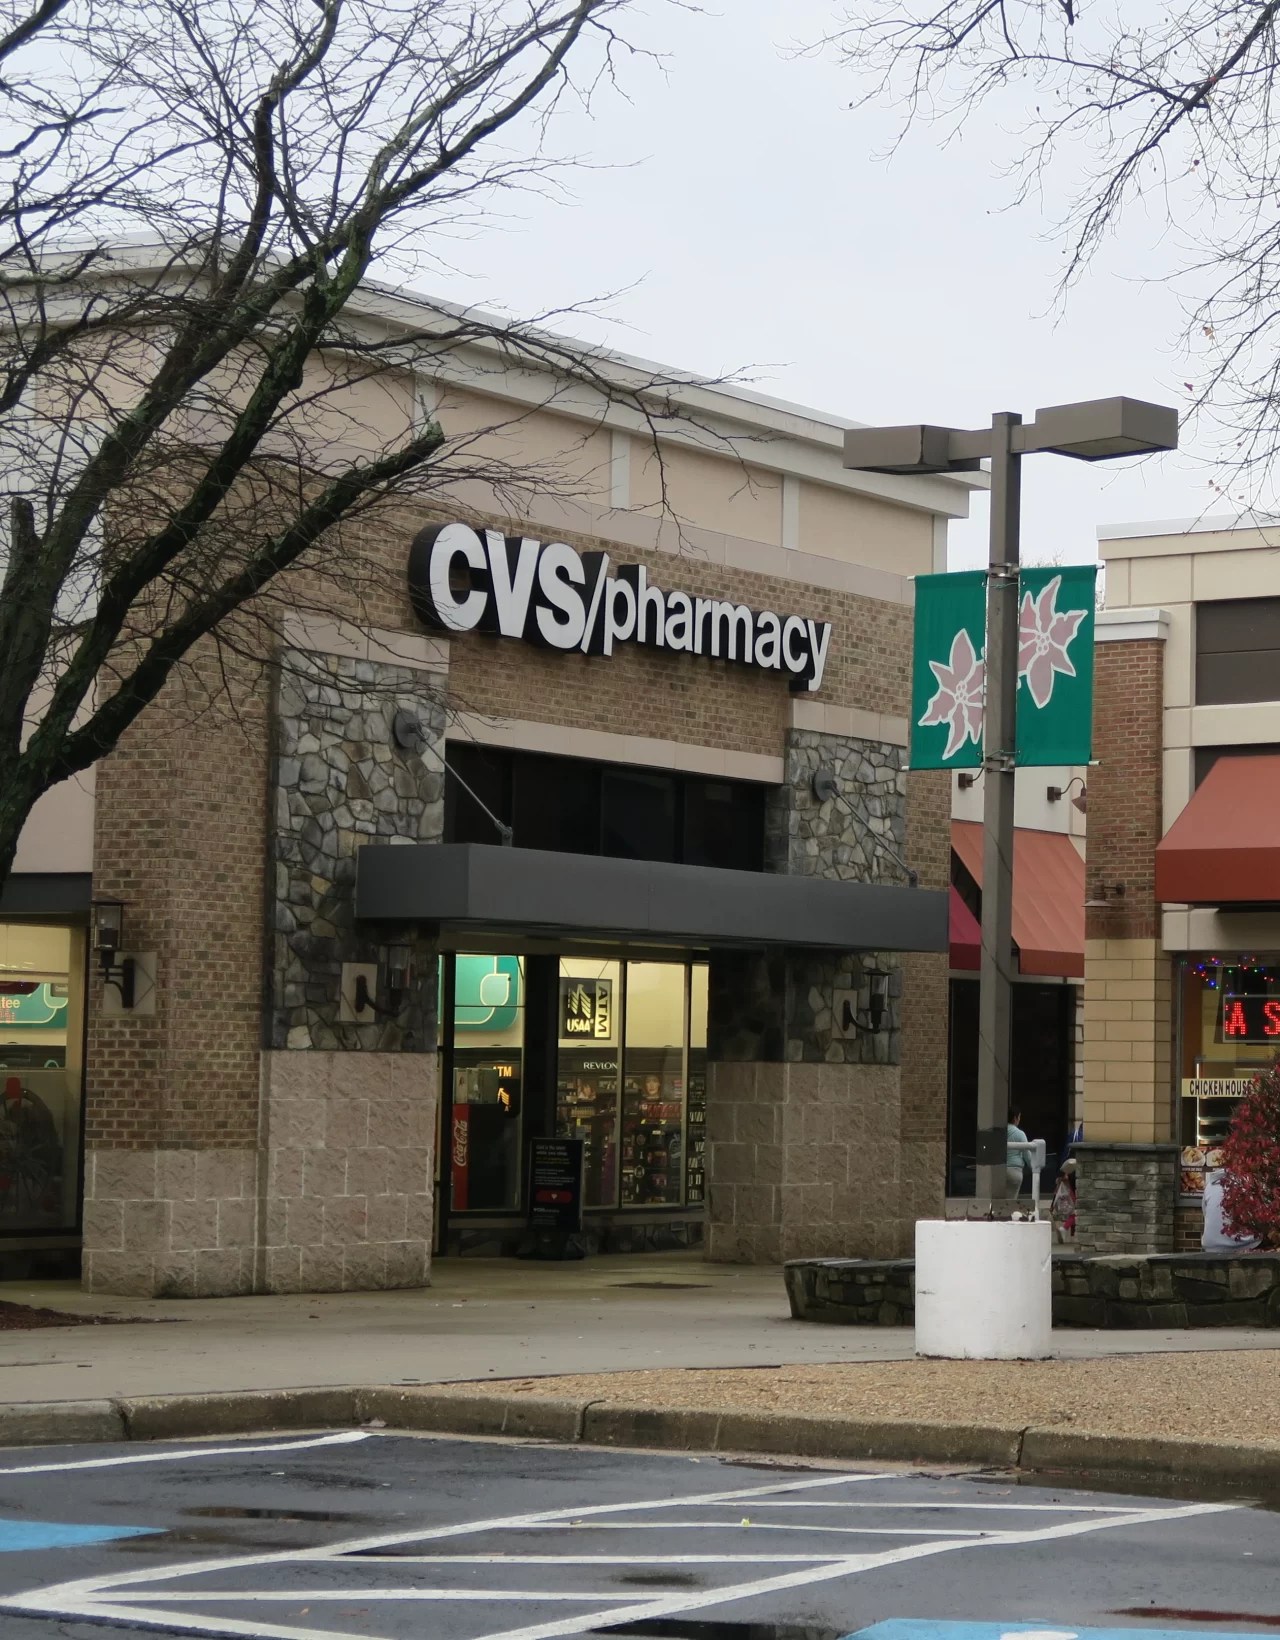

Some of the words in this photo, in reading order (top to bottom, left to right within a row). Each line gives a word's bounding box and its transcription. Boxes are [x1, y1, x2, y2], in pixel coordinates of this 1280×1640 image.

[427, 522, 832, 692] CVS/pharmacy
[0, 995, 21, 1009] tee
[598, 986, 608, 1033] ATM
[566, 1018, 592, 1032] USAA
[492, 1065, 512, 1078] TM
[583, 1061, 618, 1070] REVLON
[1189, 1080, 1224, 1096] CHICKEN
[1226, 1080, 1252, 1096] HOUS
